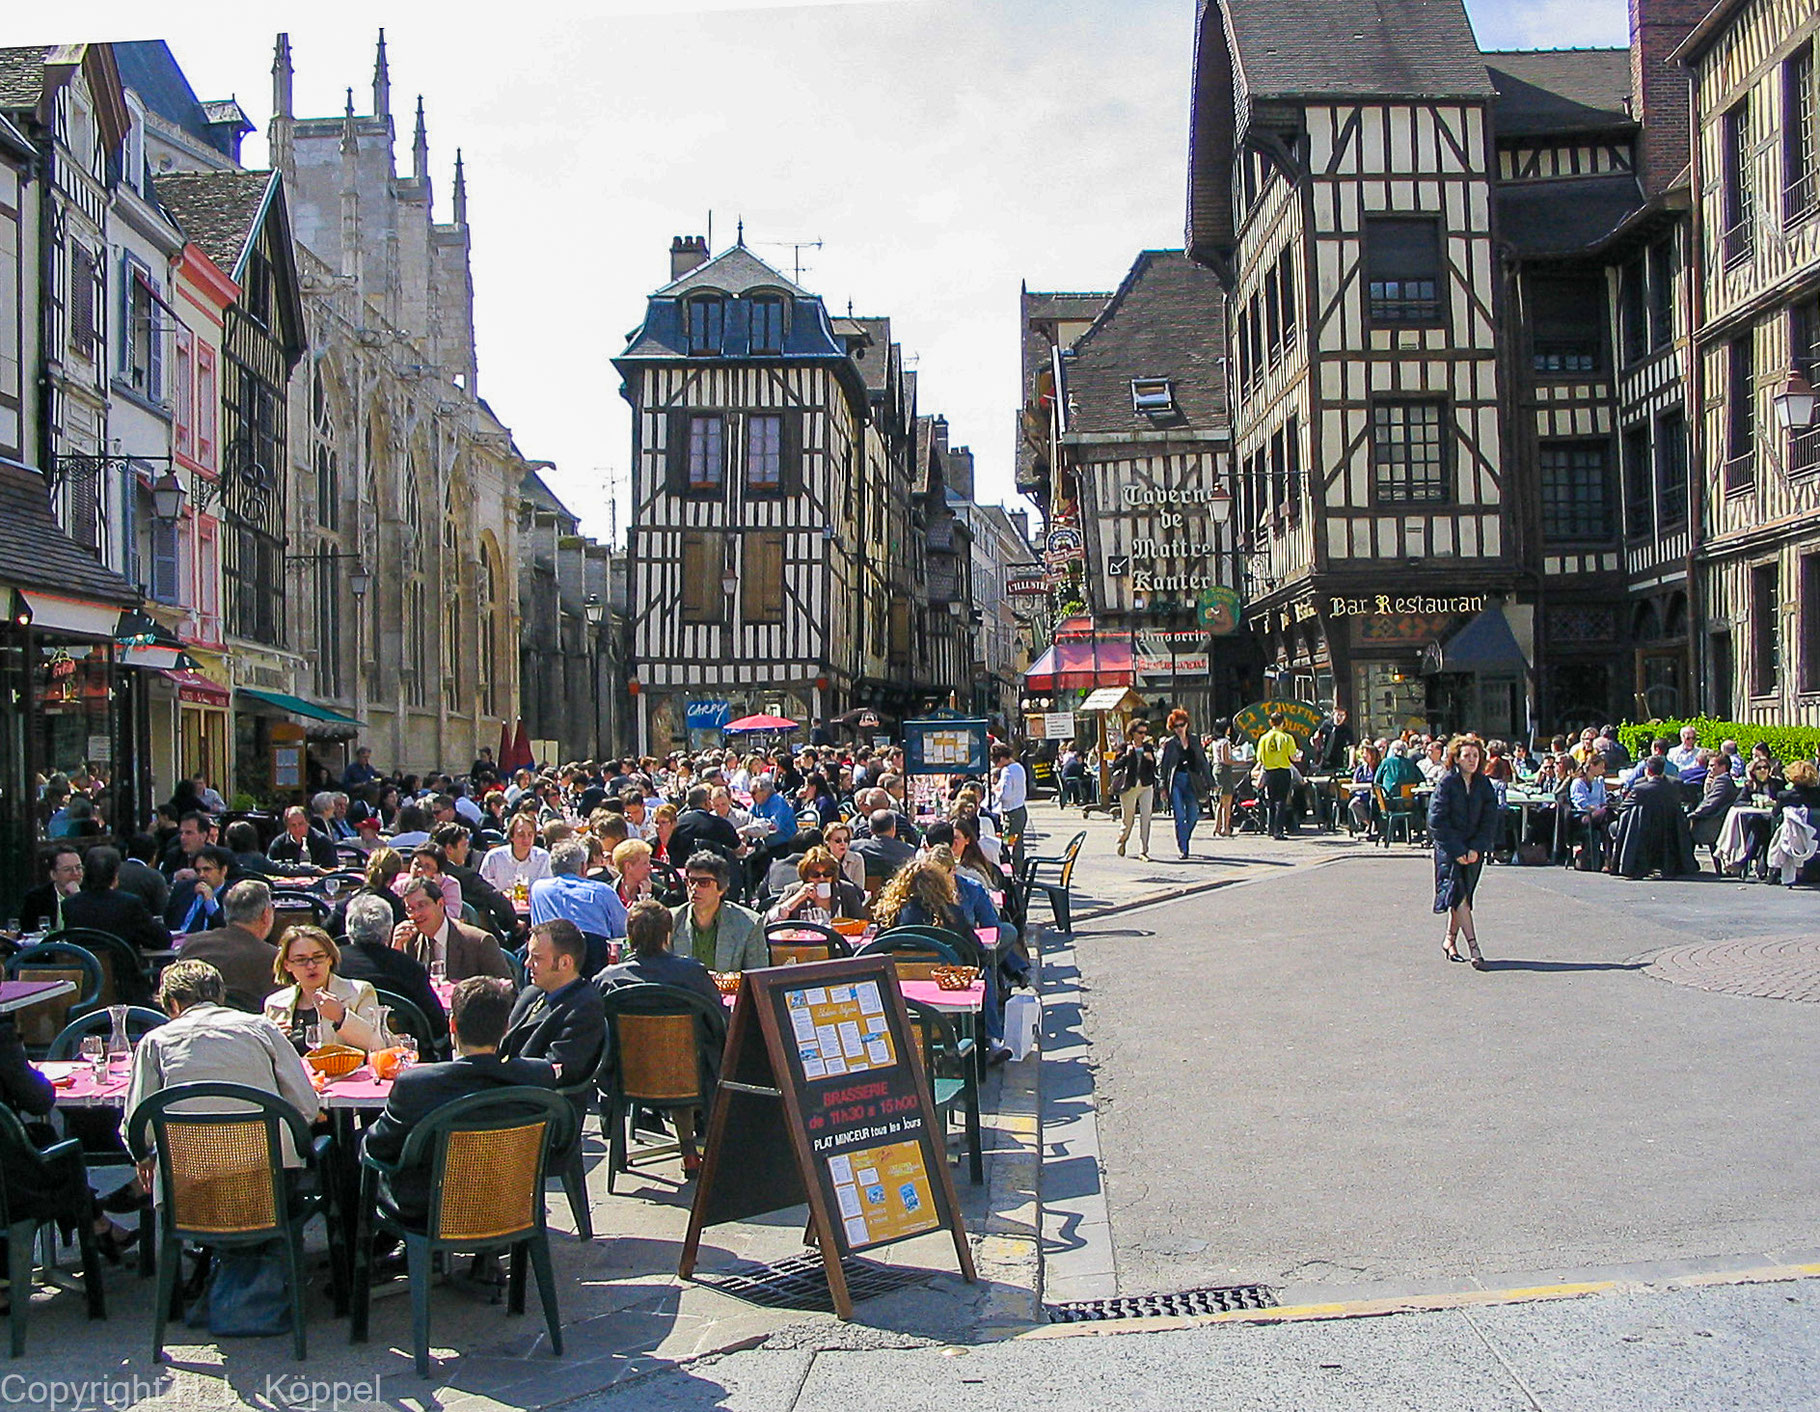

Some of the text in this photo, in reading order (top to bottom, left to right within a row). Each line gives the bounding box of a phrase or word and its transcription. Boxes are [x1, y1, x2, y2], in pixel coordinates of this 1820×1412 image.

[1160, 507, 1183, 530] de
[1132, 570, 1211, 592] Kanter
[1329, 597, 1368, 618] Bar
[1374, 594, 1487, 615] Restauran
[823, 1081, 888, 1107] BRASSERIE
[809, 1114, 825, 1130] de
[814, 1135, 833, 1151] PLAT
[834, 1127, 870, 1146] MINCEUR
